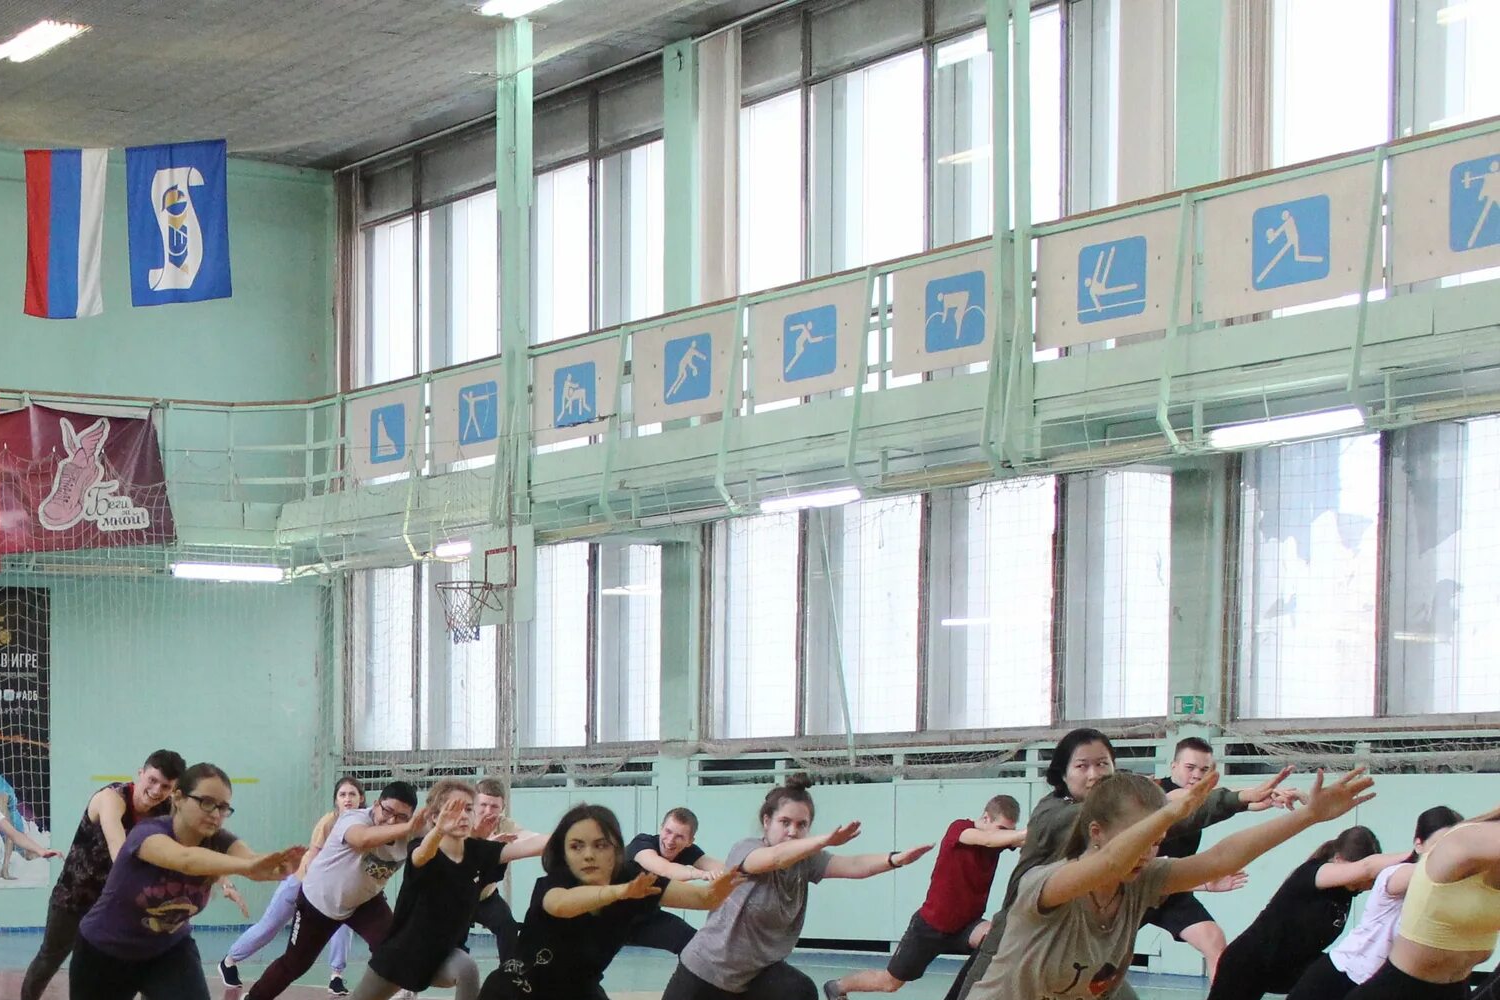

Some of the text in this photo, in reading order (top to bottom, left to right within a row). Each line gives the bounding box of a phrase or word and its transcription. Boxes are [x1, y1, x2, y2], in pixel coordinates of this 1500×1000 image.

[86, 483, 129, 516] Беги
[102, 511, 146, 526] мной!
[1, 652, 8, 667] В
[11, 653, 38, 668] ИГРЕ
